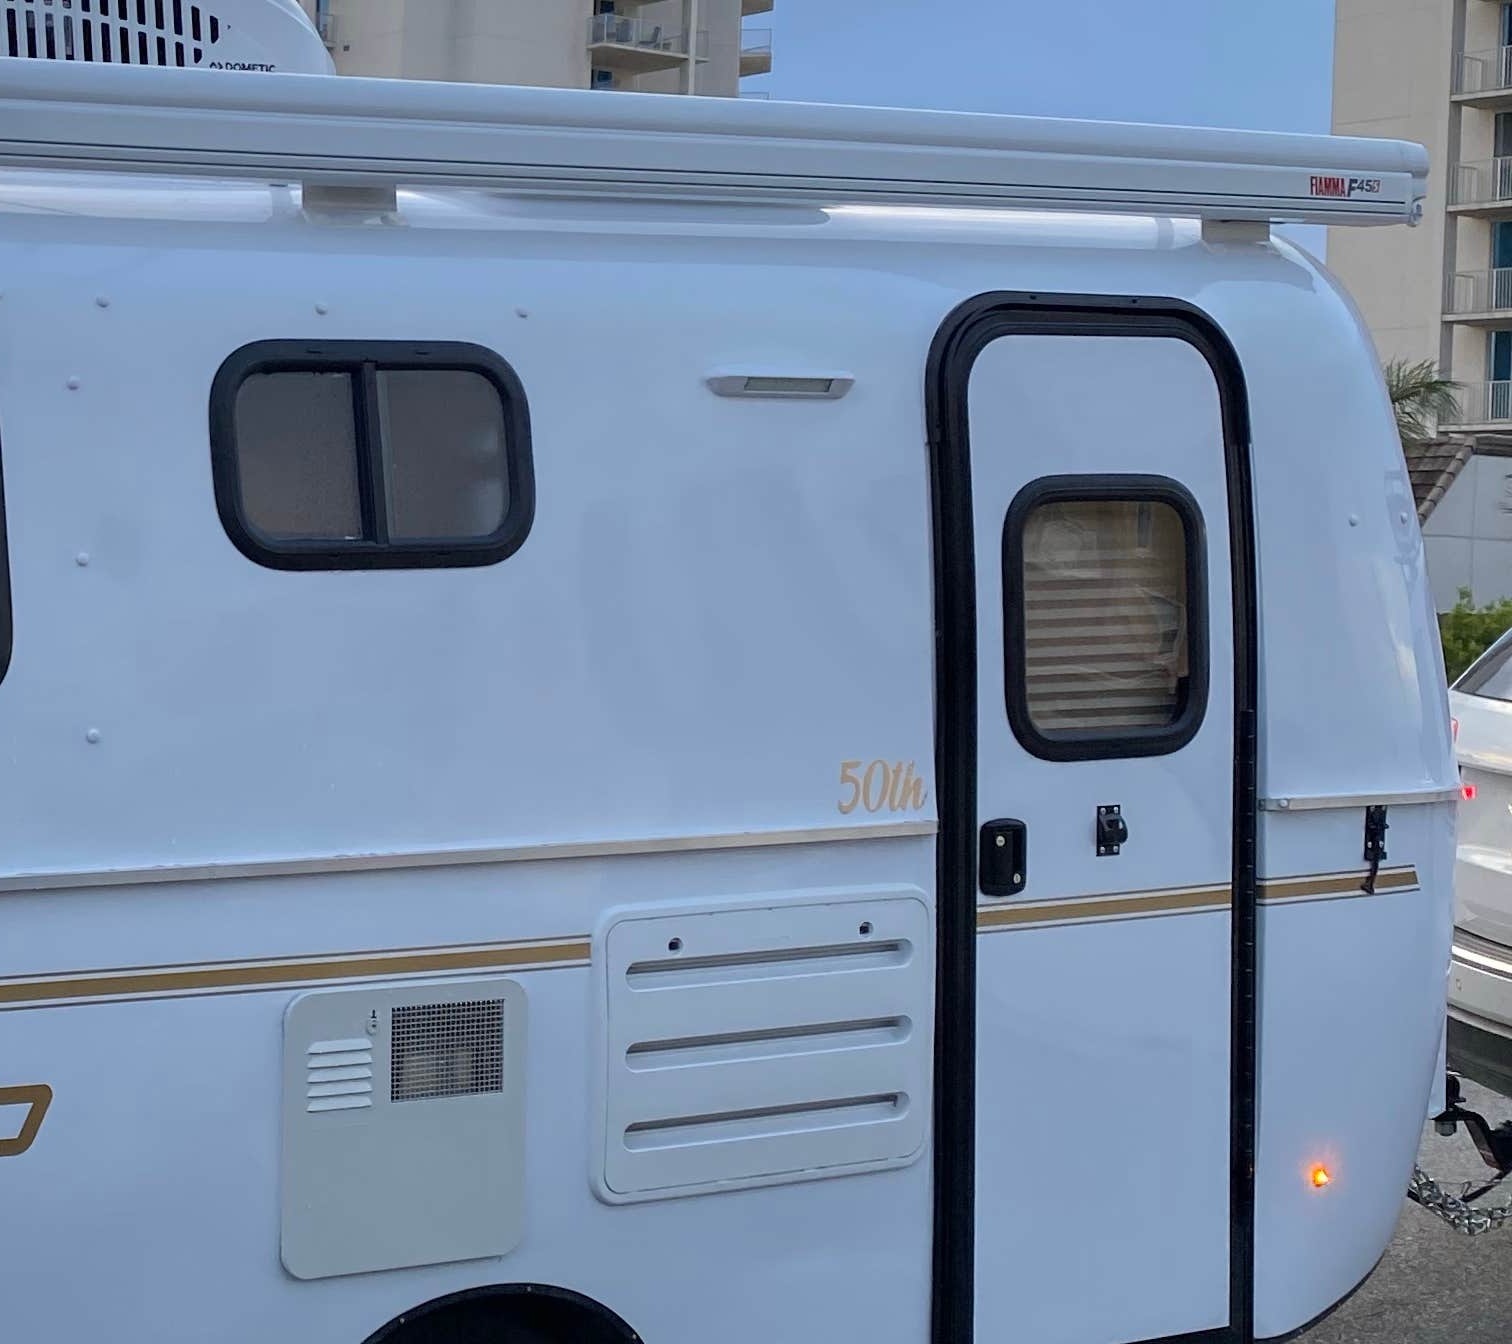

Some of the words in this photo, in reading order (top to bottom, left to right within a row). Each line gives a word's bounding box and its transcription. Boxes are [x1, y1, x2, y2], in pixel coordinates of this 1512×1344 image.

[225, 62, 276, 72] DOMETIC
[1310, 176, 1346, 197] FIAMMA
[838, 759, 928, 815] 50th
